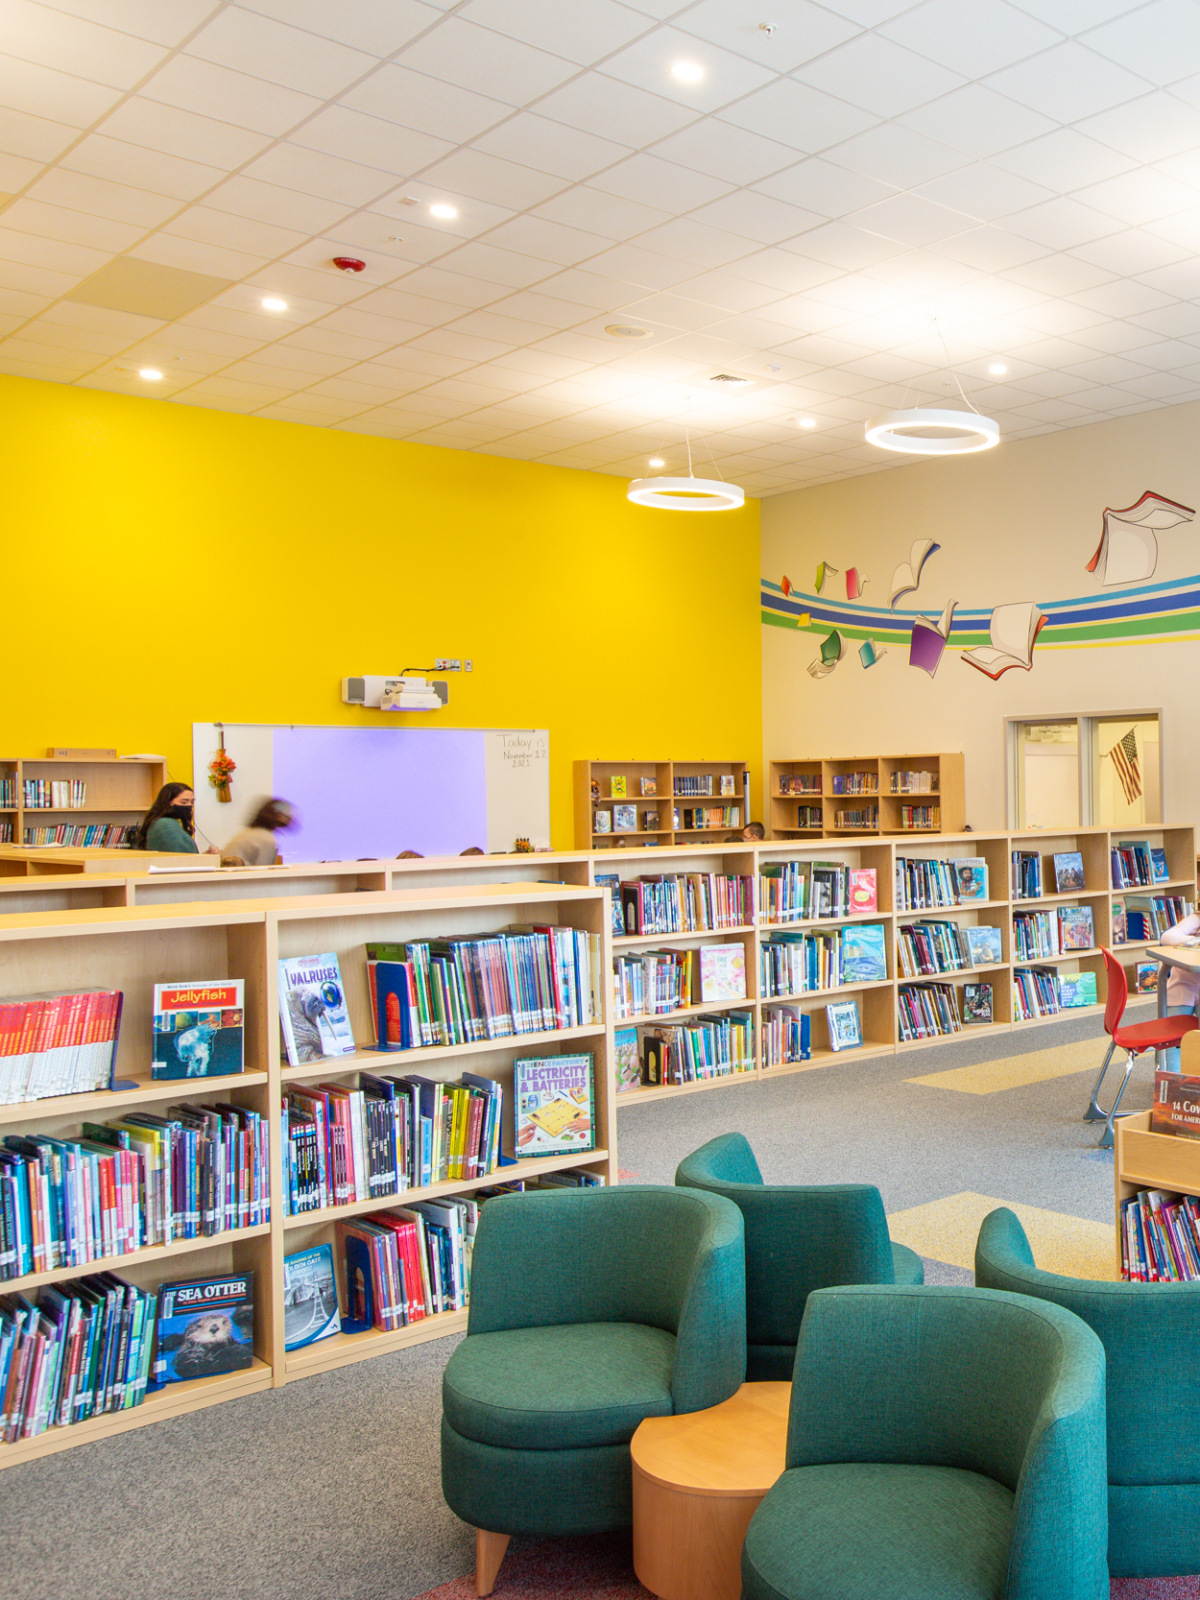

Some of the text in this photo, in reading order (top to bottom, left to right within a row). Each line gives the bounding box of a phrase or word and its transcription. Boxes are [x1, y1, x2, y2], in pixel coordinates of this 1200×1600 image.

[496, 734, 532, 751] Today
[504, 750, 533, 760] November
[512, 759, 532, 768] 2021
[171, 989, 226, 1004] Jellyfish
[552, 1058, 585, 1067] FACTORY
[526, 1064, 587, 1081] LECTRICITY
[520, 1076, 587, 1093] & BATTERIES
[1172, 1101, 1181, 1112] 14
[1171, 1113, 1183, 1123] FOR
[288, 1256, 321, 1272] OLDEN GATE
[177, 1288, 203, 1302] SEA
[204, 1281, 247, 1298] OTTER
